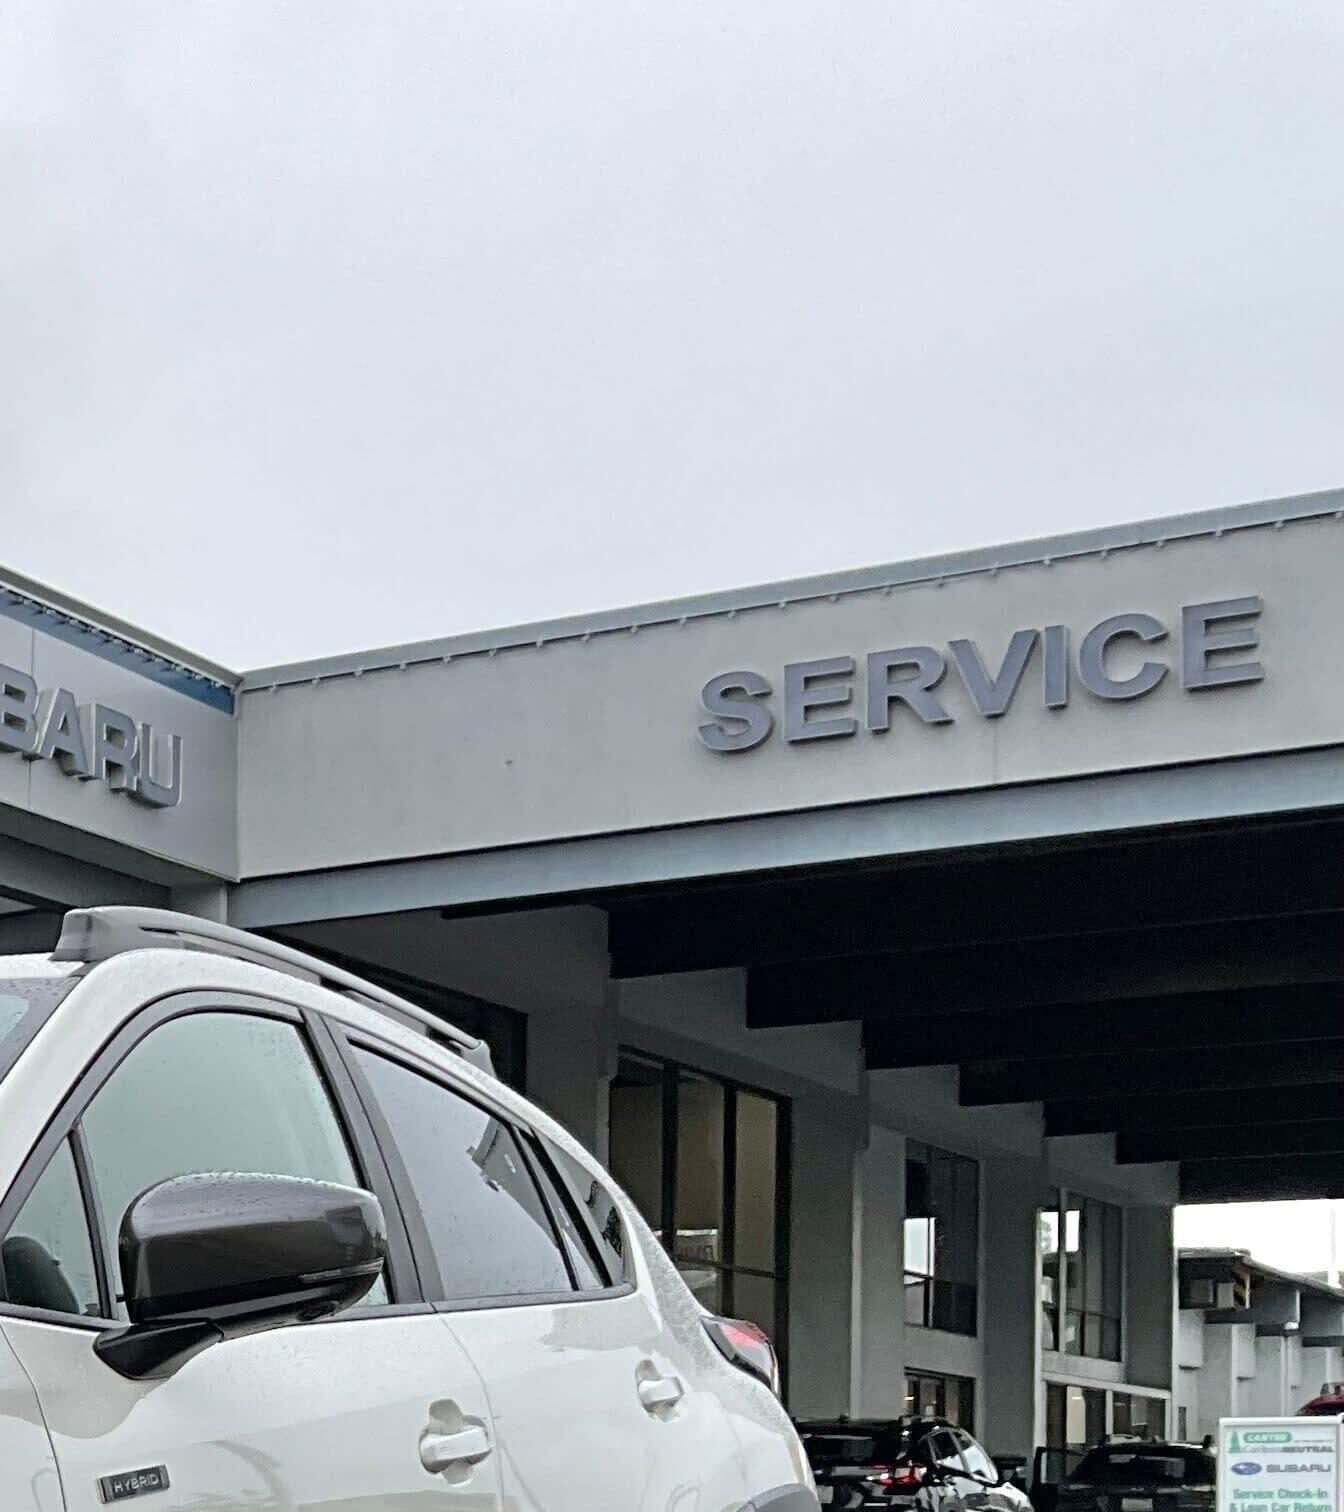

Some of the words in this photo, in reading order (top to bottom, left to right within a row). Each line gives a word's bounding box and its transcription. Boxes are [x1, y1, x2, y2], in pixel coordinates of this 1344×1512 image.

[697, 595, 1265, 752] SERVICE
[1266, 1464, 1332, 1473] SUBARU
[113, 1473, 160, 1494] HYBRID
[1233, 1488, 1274, 1499] Service
[1278, 1488, 1328, 1499] Check-In
[1241, 1503, 1268, 1512] Loan
[1272, 1503, 1290, 1512] Car
[1294, 1503, 1332, 1512] Return
